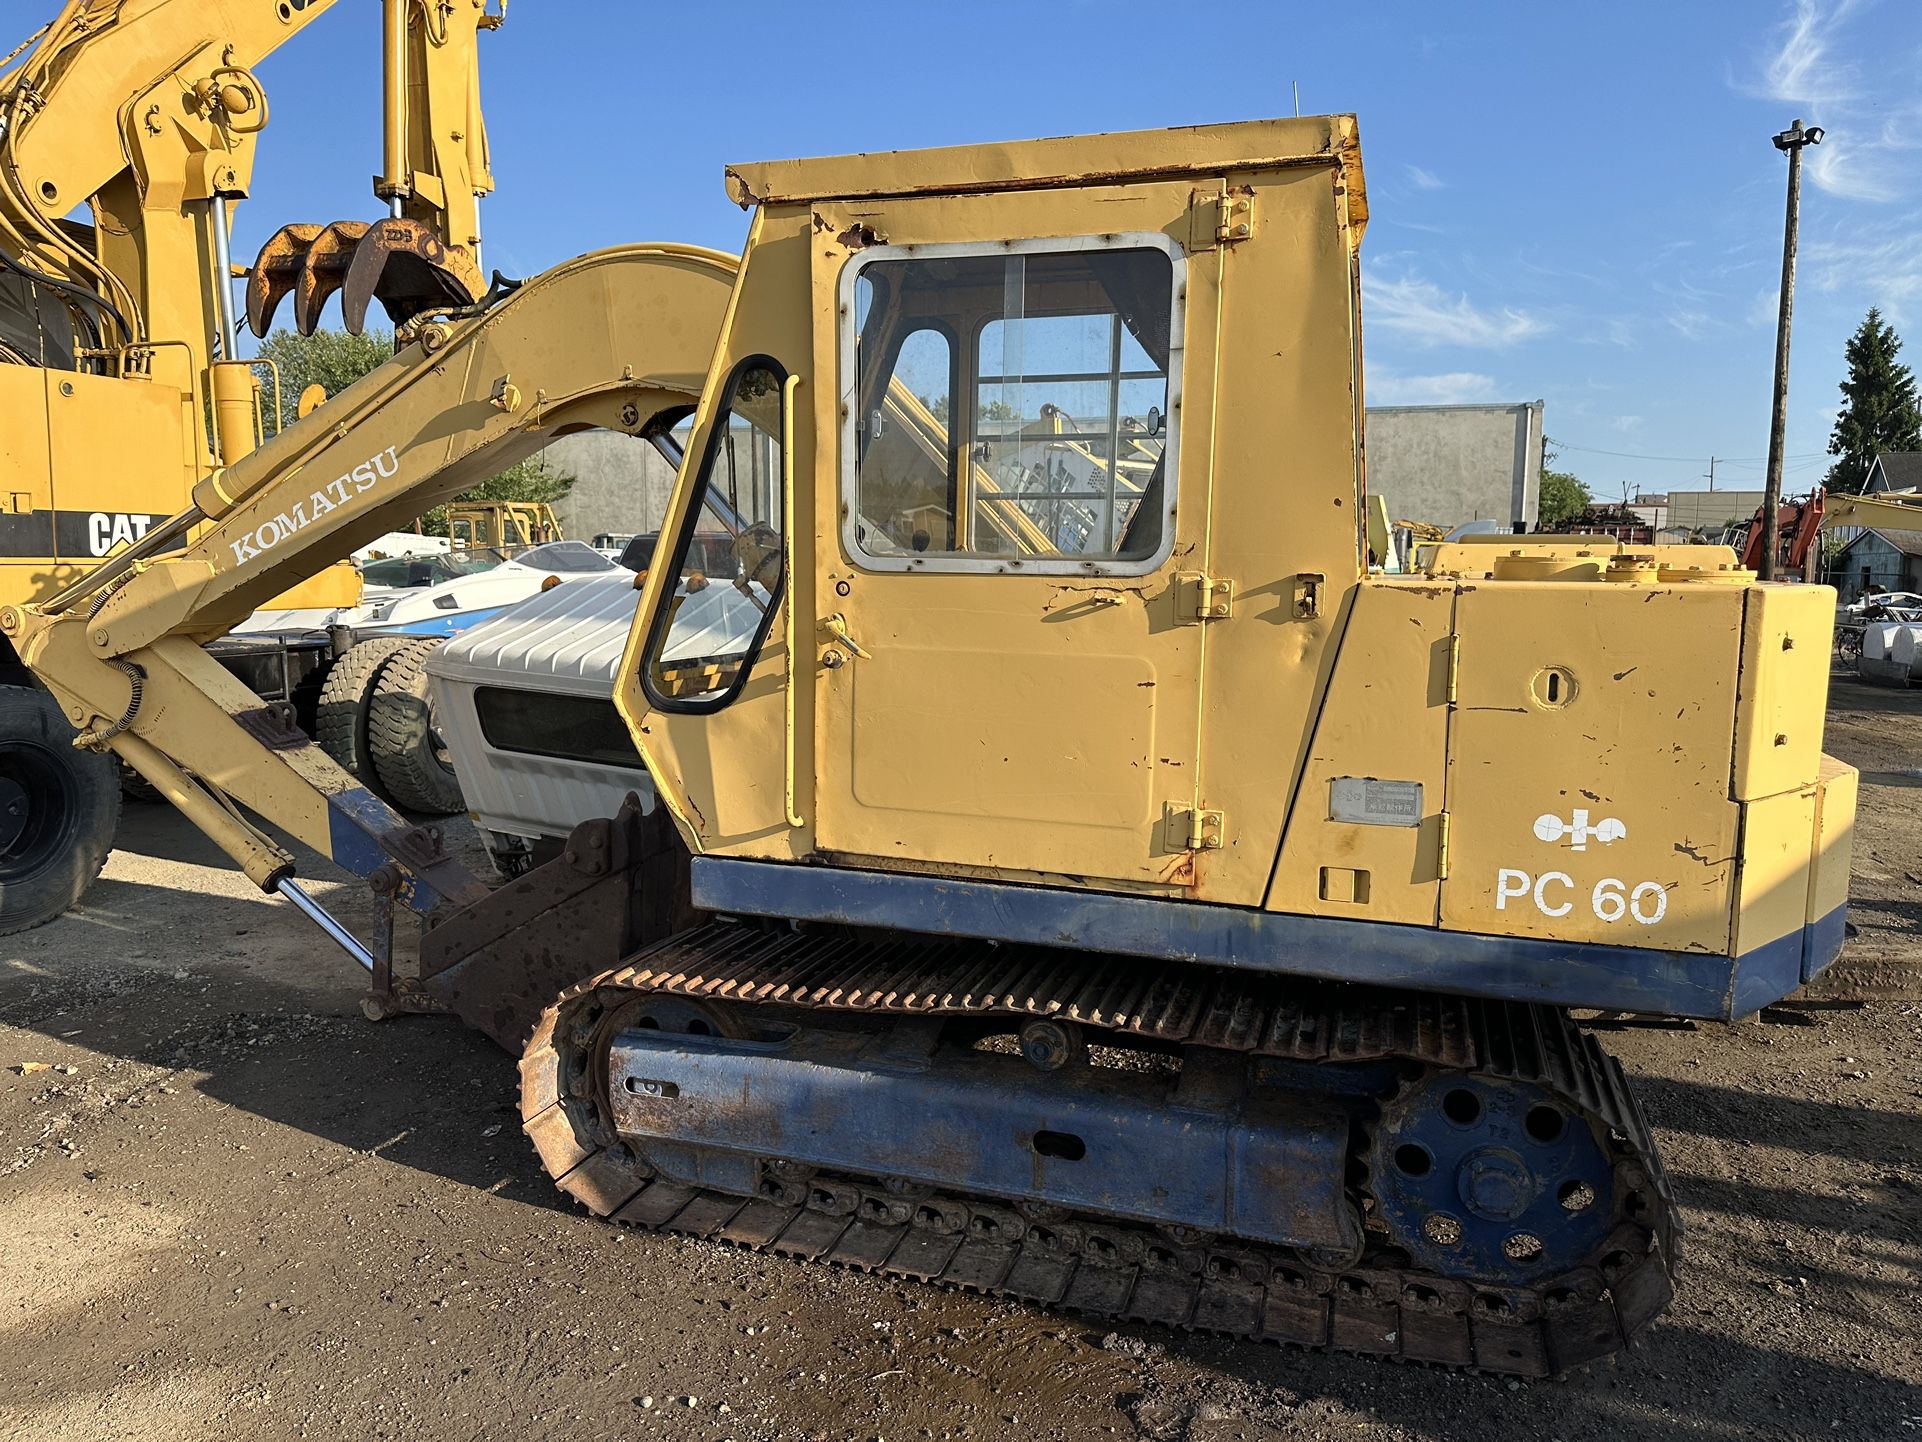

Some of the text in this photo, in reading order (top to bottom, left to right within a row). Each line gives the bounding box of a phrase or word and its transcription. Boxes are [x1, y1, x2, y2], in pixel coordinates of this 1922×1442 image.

[88, 512, 151, 557] CAT
[229, 445, 399, 567] KOMATSU
[1496, 868, 1668, 925] PC 60
